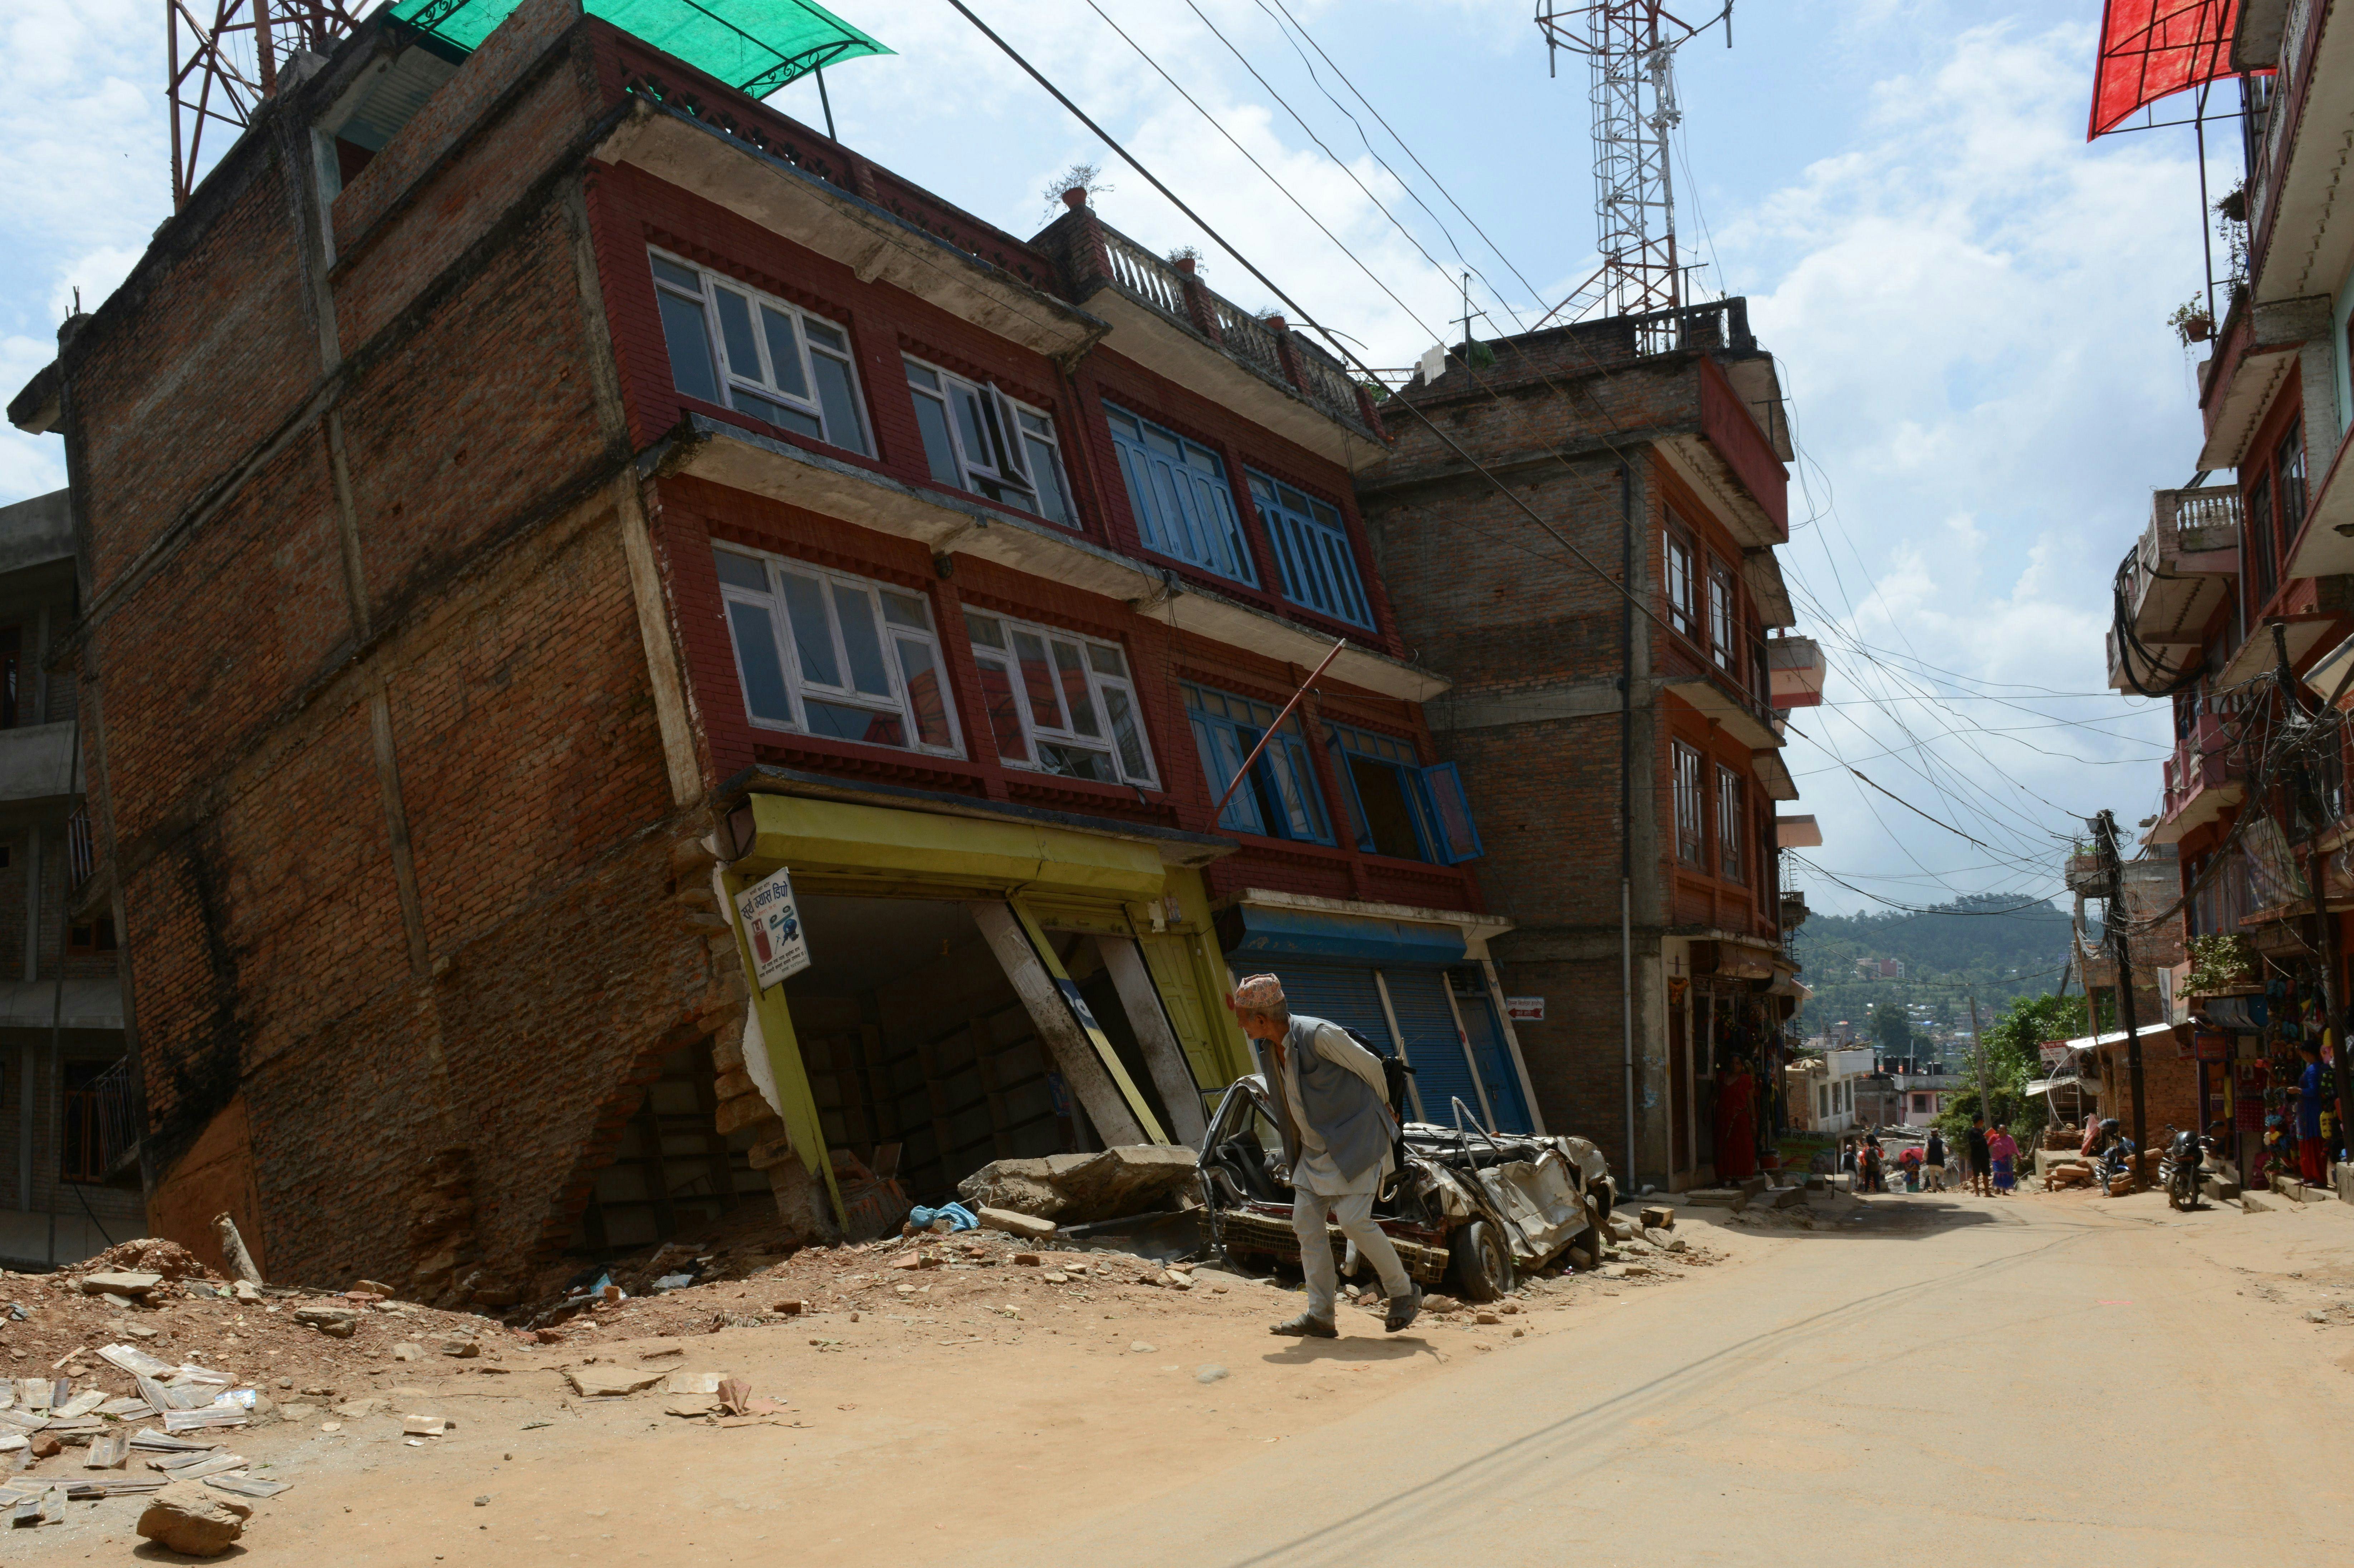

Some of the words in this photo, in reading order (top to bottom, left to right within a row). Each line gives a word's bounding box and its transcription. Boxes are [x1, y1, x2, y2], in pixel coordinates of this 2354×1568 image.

[741, 898, 755, 920] सूर्य
[753, 889, 772, 908] ग्यास
[773, 881, 788, 900] डिपो
